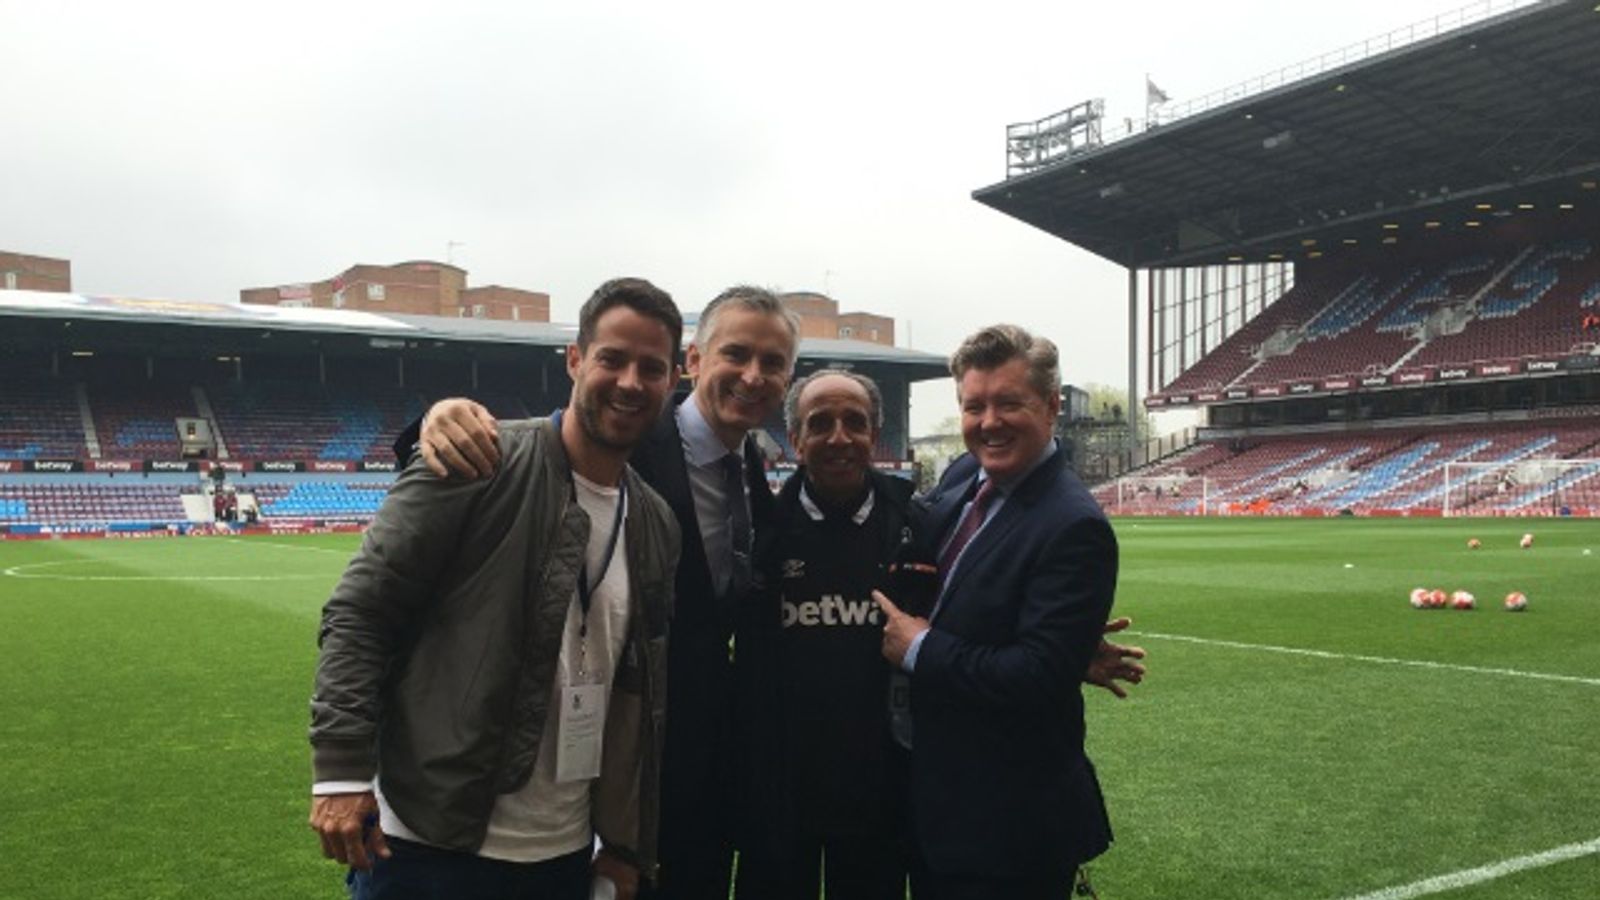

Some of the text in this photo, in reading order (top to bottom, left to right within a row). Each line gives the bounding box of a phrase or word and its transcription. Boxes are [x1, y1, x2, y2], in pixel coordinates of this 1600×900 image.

[34, 461, 73, 471] betway
[95, 461, 131, 471] betway
[152, 461, 188, 471] betway
